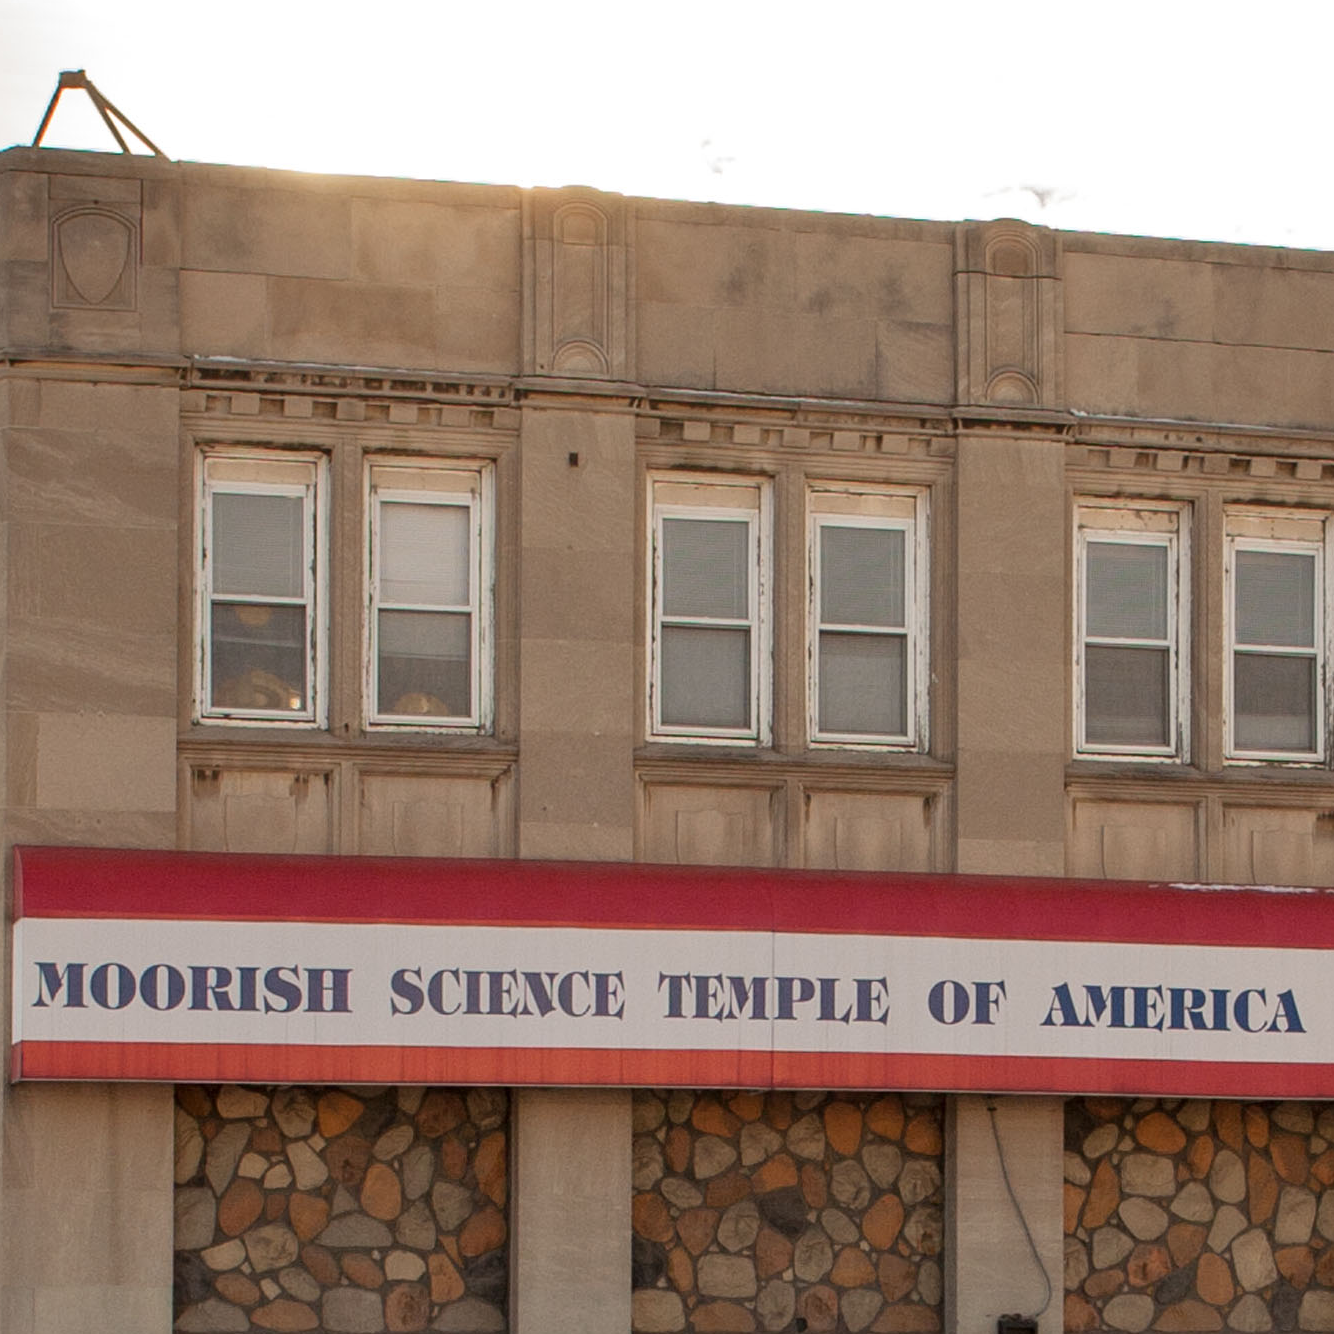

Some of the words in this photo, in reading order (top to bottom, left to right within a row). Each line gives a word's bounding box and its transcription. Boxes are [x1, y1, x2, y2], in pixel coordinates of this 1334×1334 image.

[32, 961, 353, 1014] MOORISH
[390, 967, 625, 1019] SCIENCE
[658, 972, 890, 1023] TEMPLE
[927, 979, 1007, 1025] OF
[1040, 983, 1307, 1033] AMERICA
